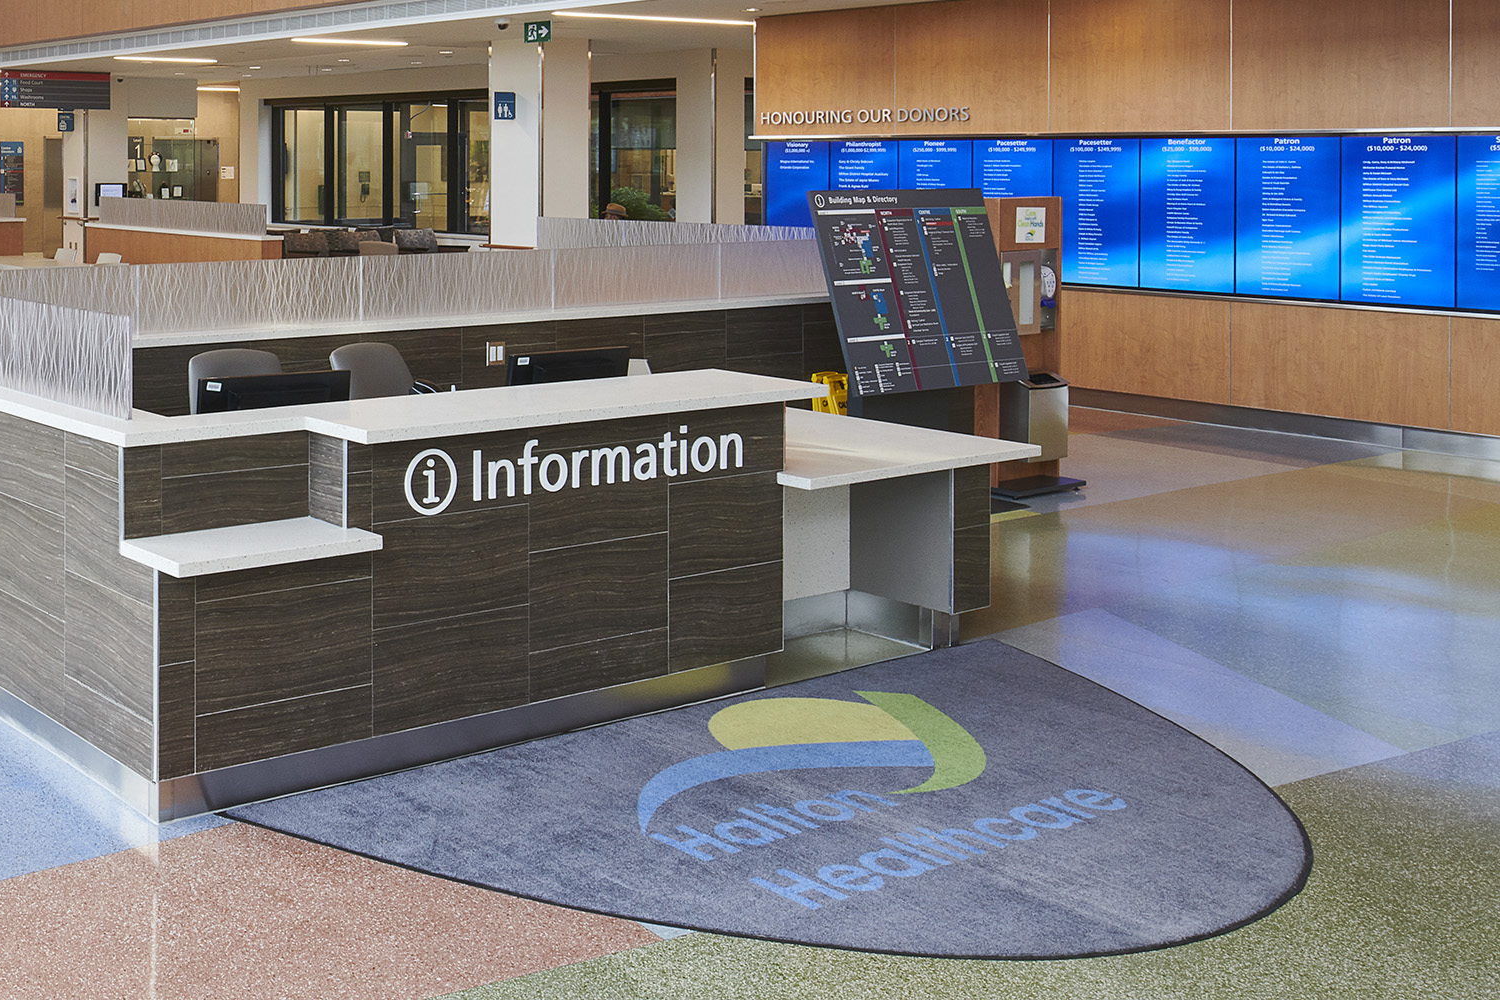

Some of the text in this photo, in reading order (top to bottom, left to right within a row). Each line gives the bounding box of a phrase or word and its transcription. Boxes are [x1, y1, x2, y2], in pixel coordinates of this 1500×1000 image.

[760, 106, 970, 125] HONOURING OUR DONORS
[135, 144, 140, 158] 1
[828, 195, 852, 205] Building
[853, 196, 865, 205] Map
[873, 195, 898, 204] Directory
[472, 425, 743, 502] Information
[652, 788, 899, 862] Halton
[750, 787, 1128, 910] Healthcare
